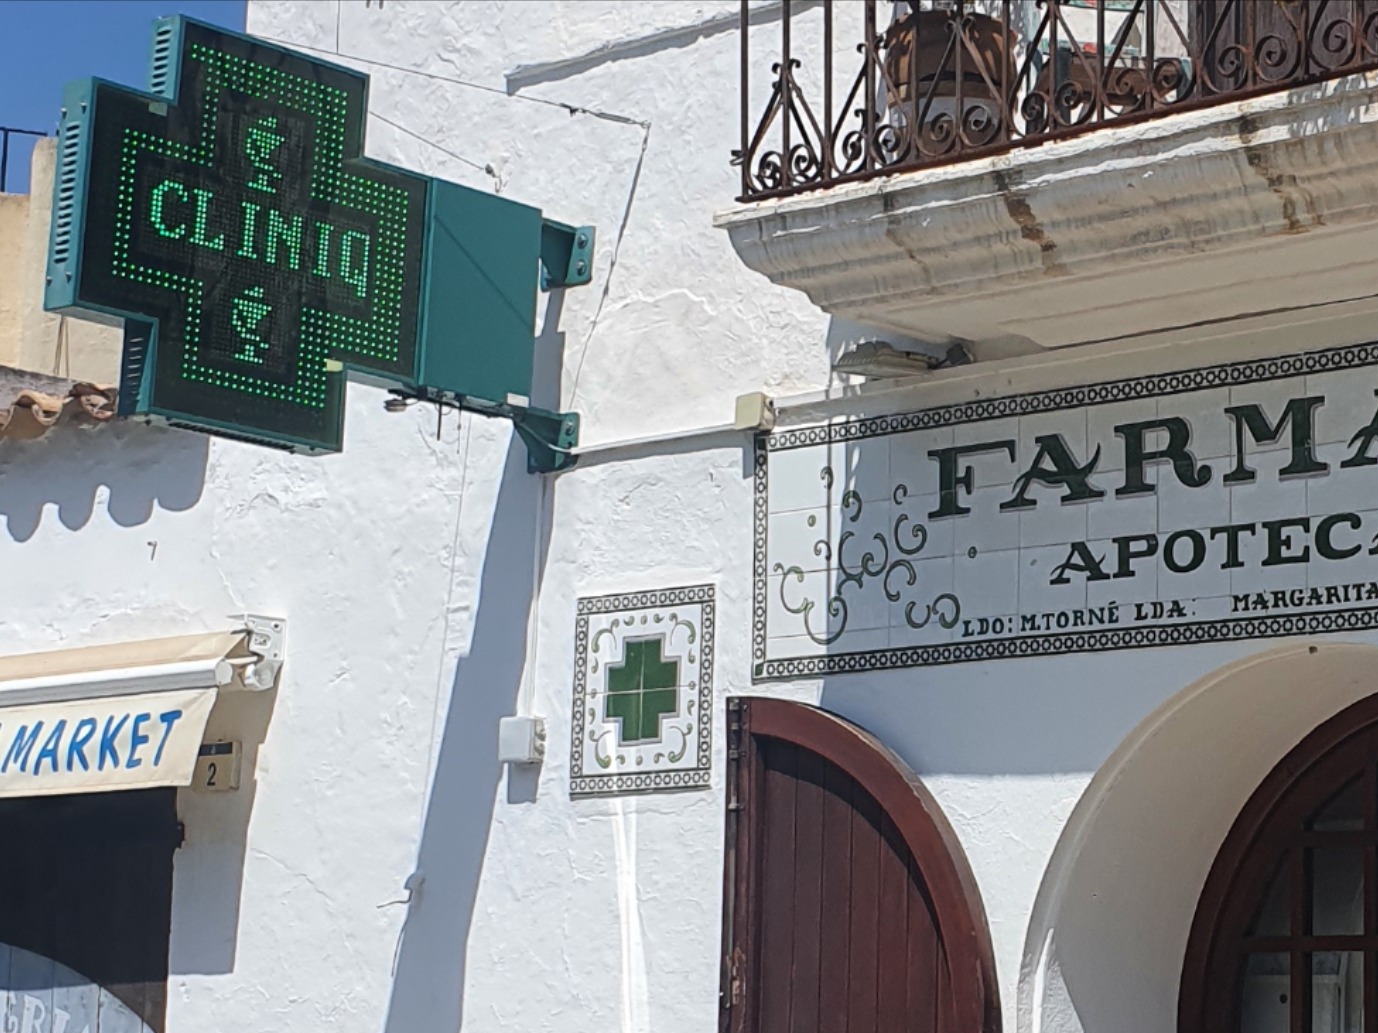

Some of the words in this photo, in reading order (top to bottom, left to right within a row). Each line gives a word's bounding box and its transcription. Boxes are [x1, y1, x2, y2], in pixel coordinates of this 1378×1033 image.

[148, 179, 371, 299] CLINIQ
[1, 709, 183, 776] MARKET
[207, 762, 216, 786] 2
